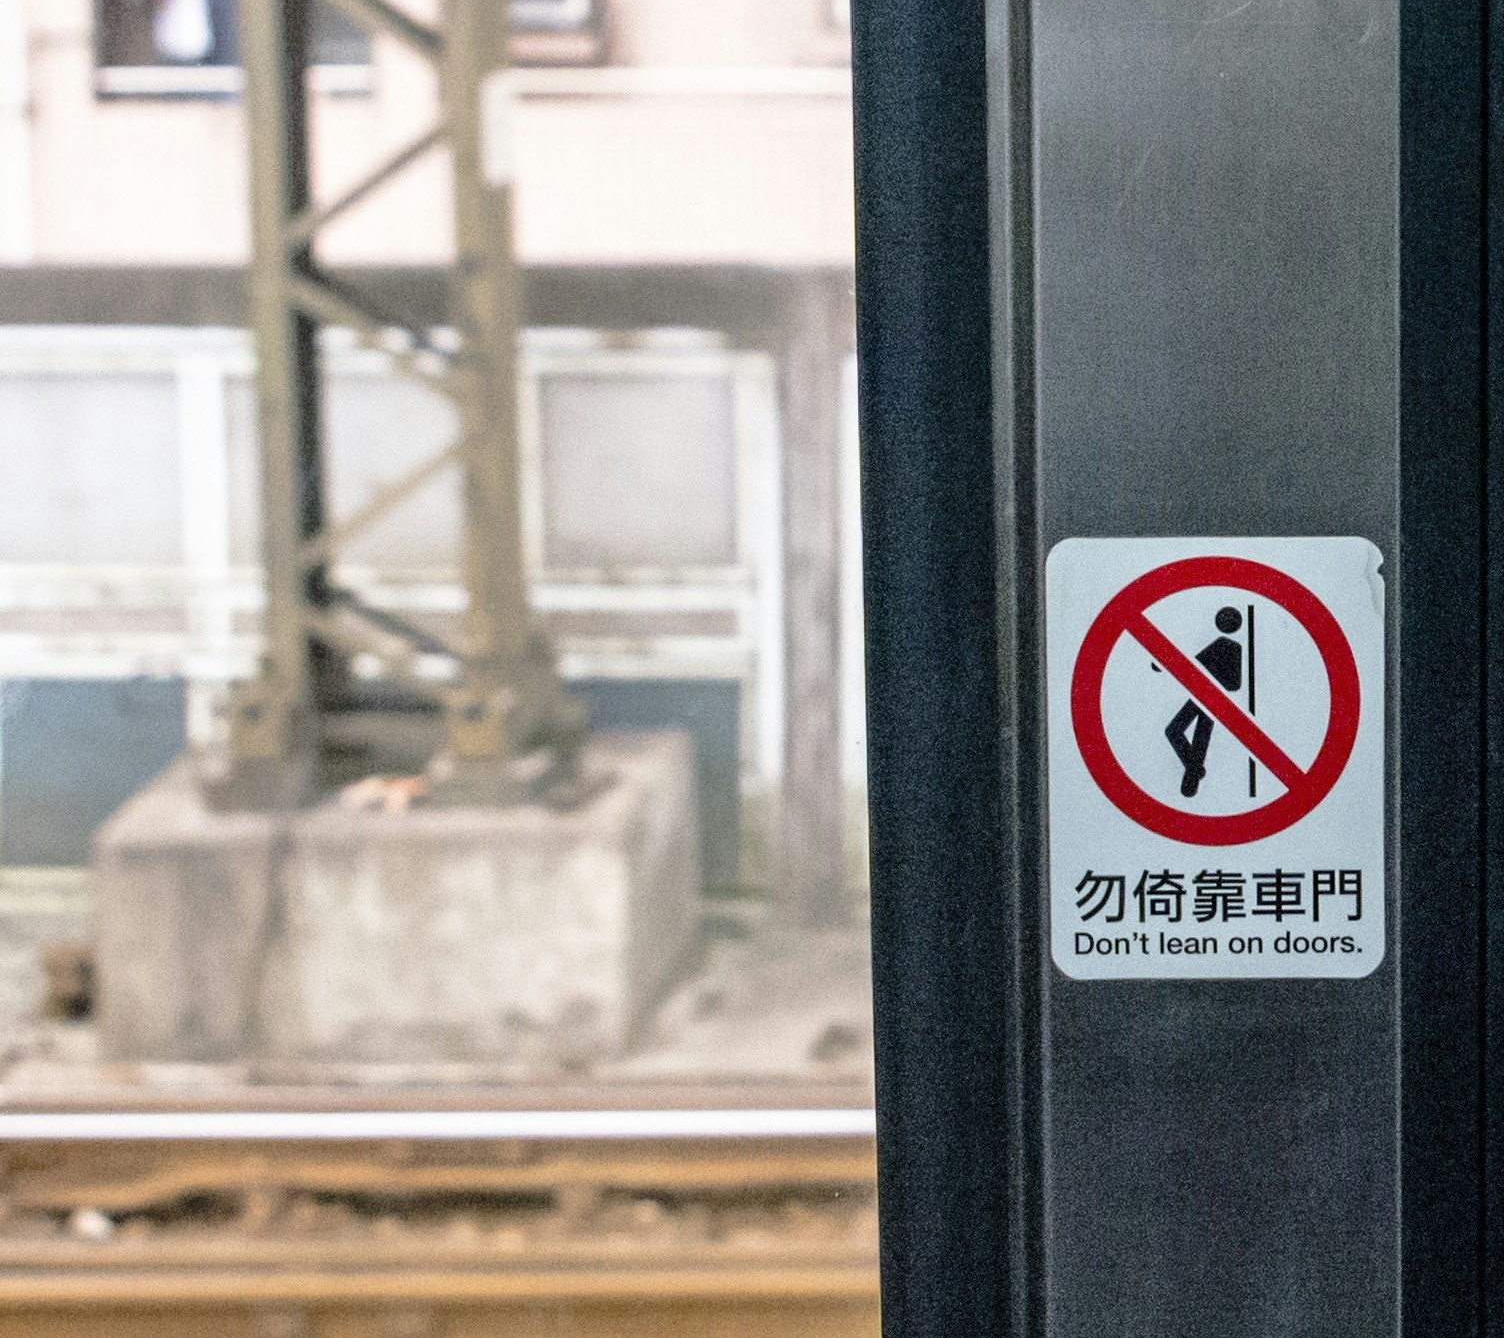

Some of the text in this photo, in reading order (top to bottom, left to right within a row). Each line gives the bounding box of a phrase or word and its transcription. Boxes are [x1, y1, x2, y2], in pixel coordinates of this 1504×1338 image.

[1075, 868, 1363, 923] 勿倚靠車門
[1074, 930, 1363, 956] Don’t lean on doors.
